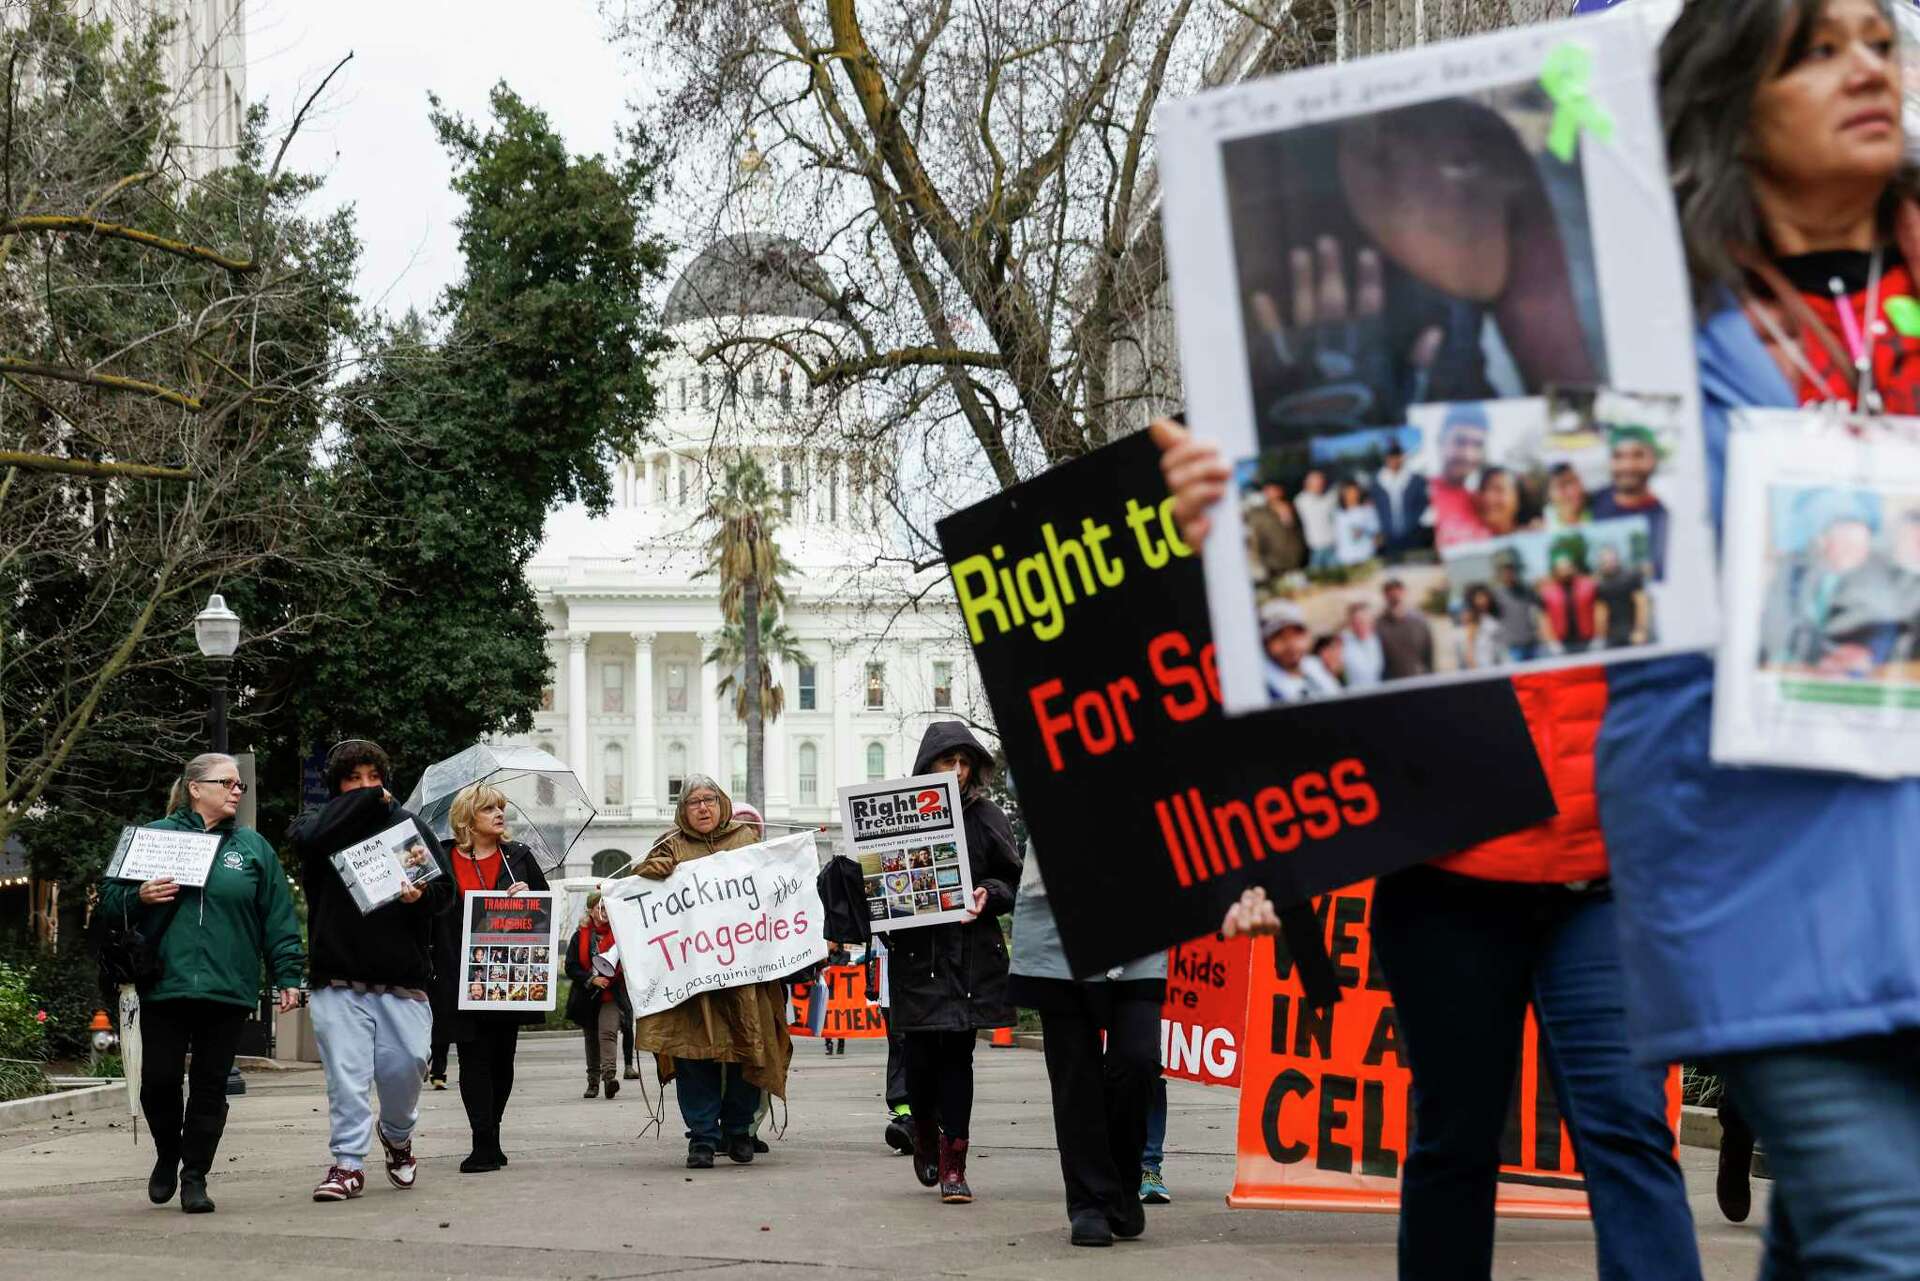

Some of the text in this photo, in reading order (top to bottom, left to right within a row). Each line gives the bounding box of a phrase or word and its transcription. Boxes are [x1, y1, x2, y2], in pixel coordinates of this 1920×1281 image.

[950, 518, 1125, 646] Right
[1028, 676, 1141, 772] For
[855, 806, 950, 831] Treatment
[1154, 757, 1381, 889] Illness
[484, 898, 541, 912] TRACKING THE
[623, 873, 803, 928] Tracking the
[648, 910, 808, 972] Tragedies
[1173, 945, 1226, 989] kids
[1271, 994, 1410, 1068] IN A
[1261, 1068, 1416, 1179] CEL
